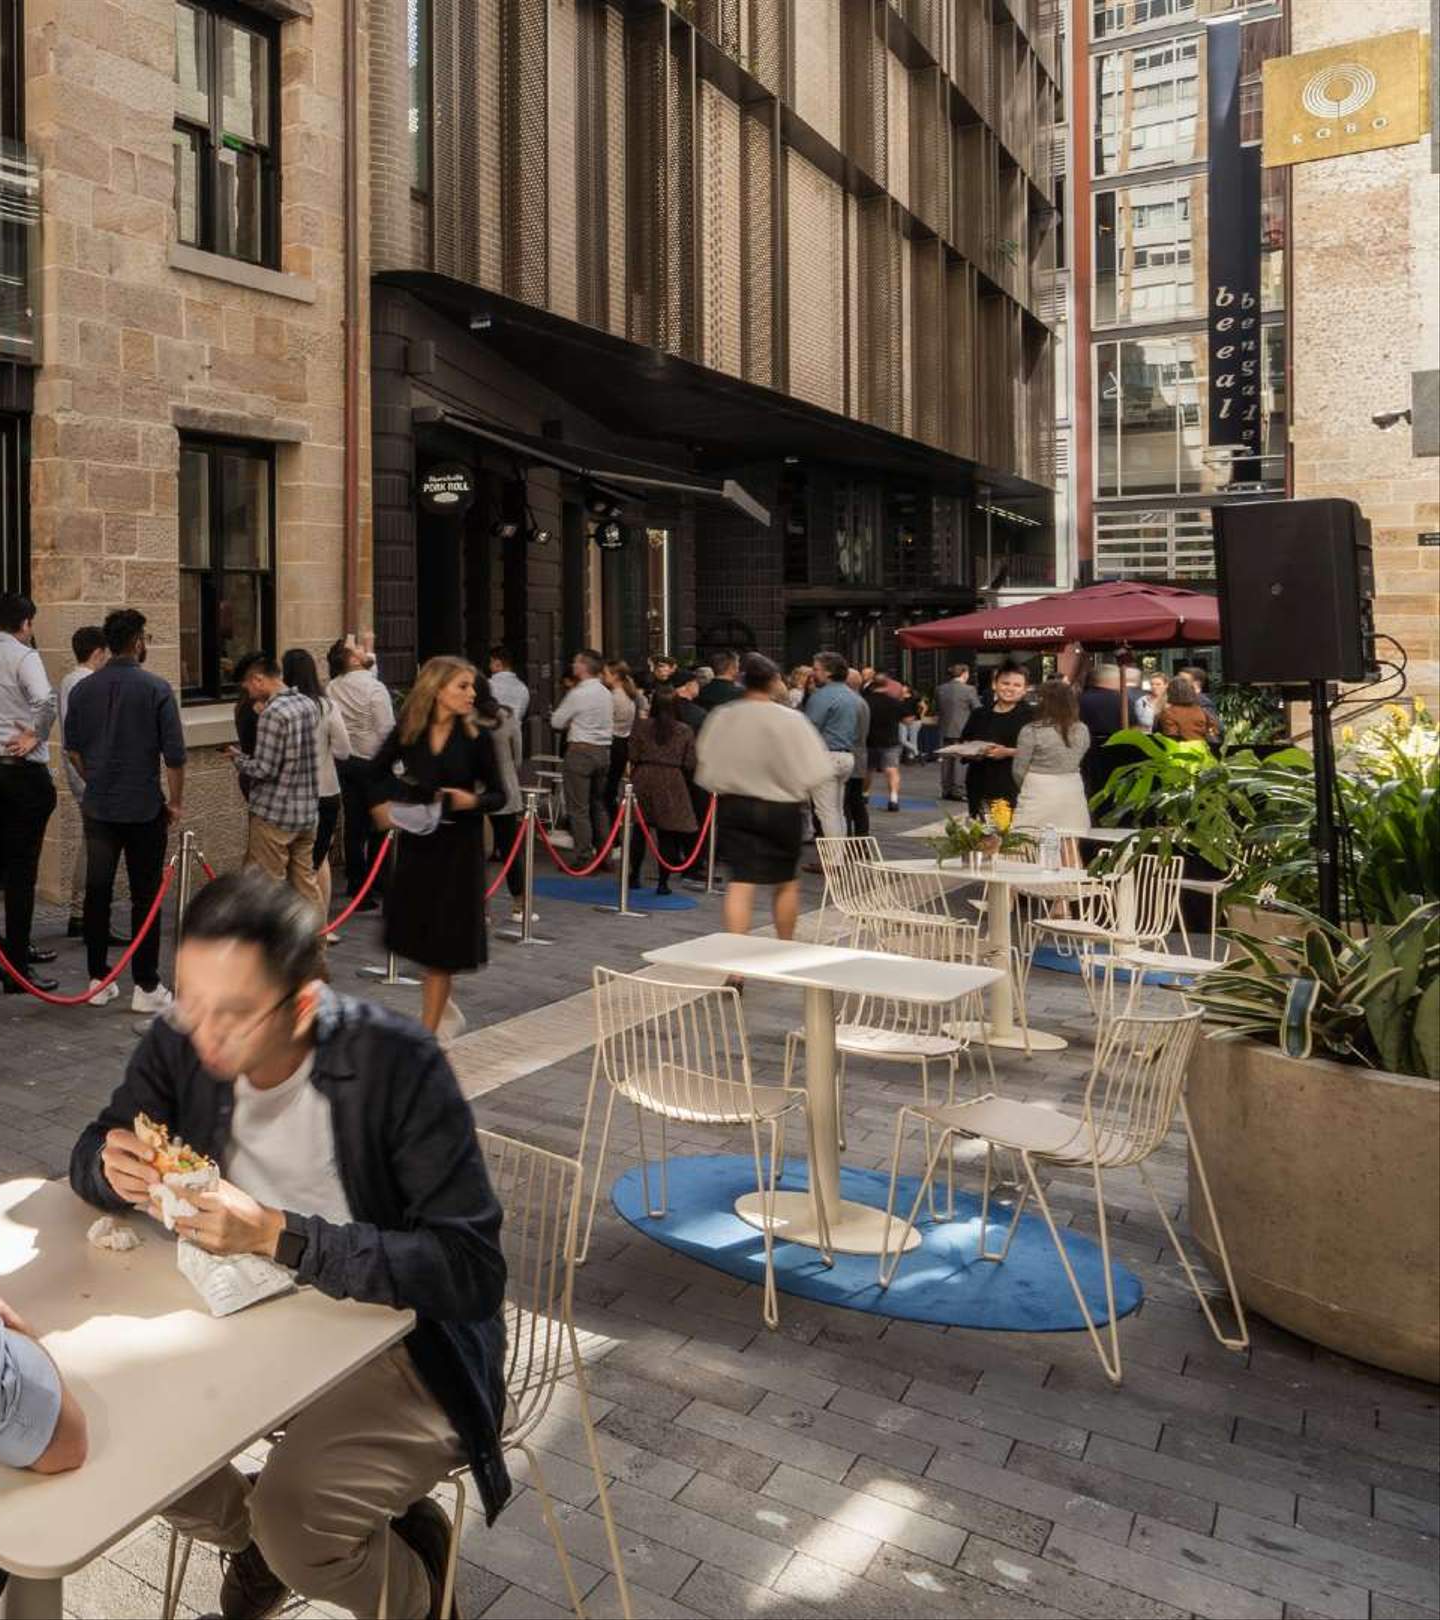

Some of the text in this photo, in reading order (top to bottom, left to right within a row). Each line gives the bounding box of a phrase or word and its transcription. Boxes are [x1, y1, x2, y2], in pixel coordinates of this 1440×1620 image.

[1291, 117, 1388, 145] KOBO
[1215, 286, 1236, 420] beeal
[983, 629, 1007, 640] BAR
